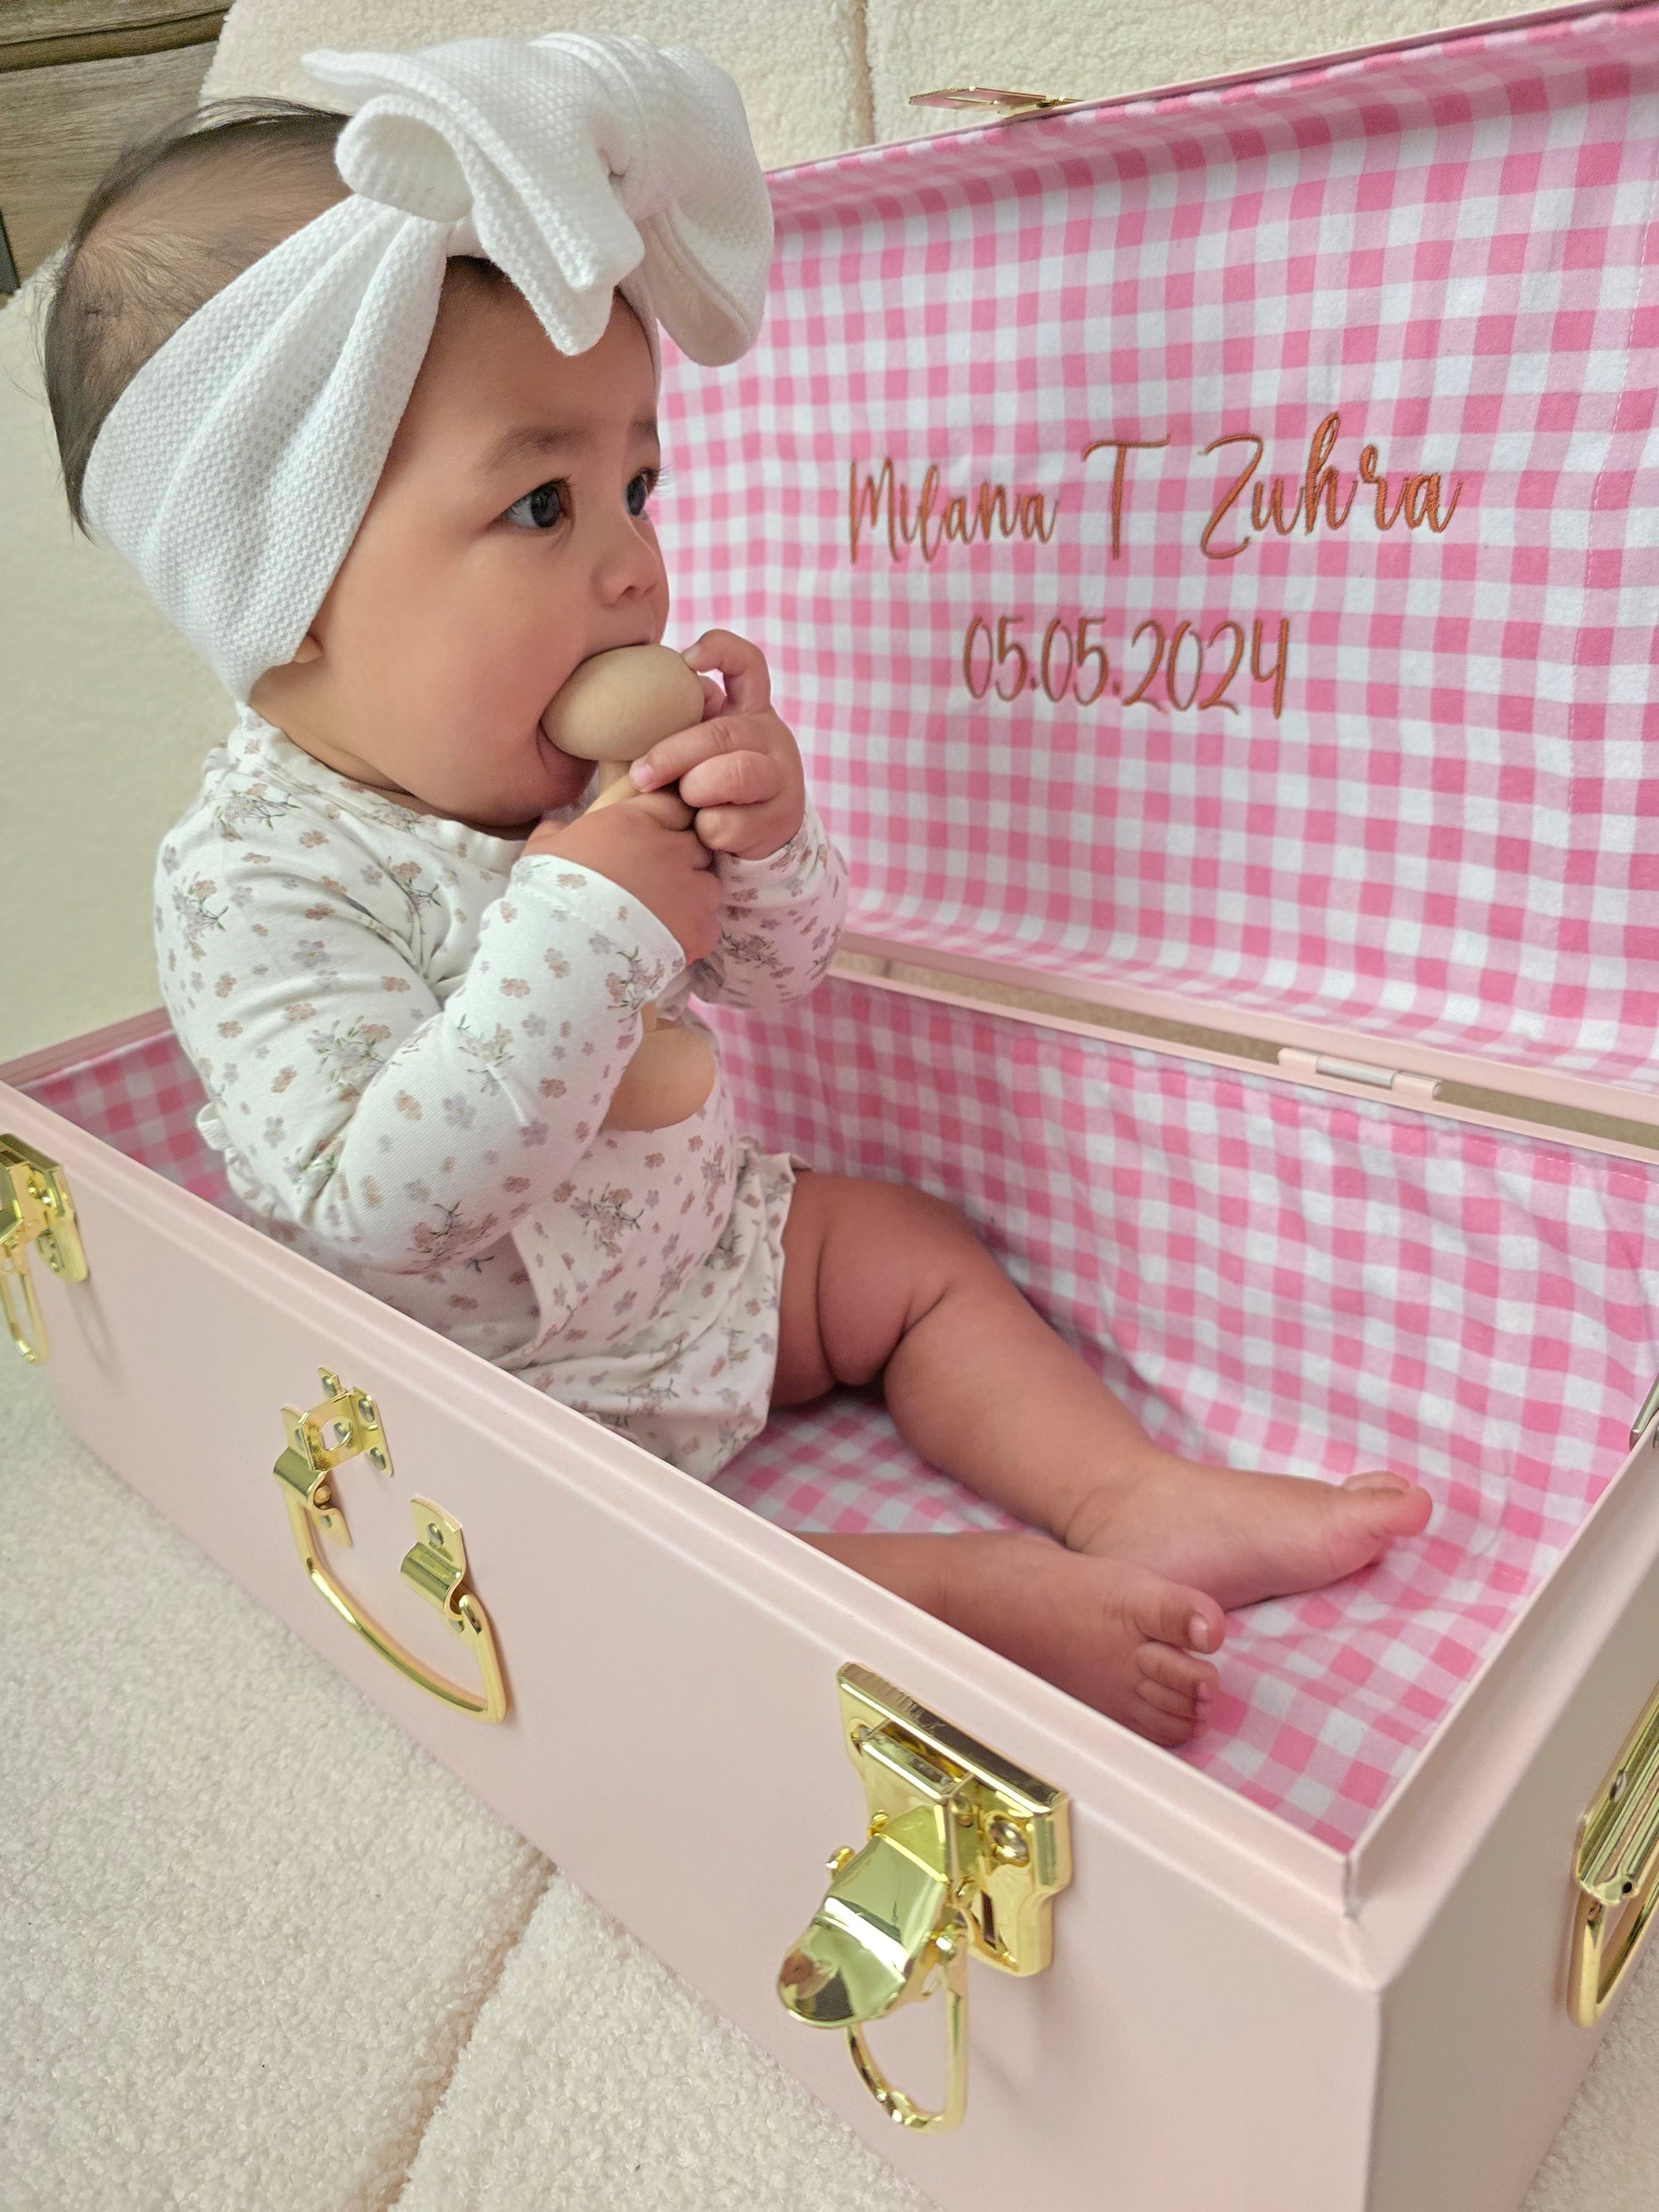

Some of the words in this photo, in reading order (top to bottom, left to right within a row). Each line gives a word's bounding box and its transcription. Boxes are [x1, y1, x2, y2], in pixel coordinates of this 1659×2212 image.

[849, 457, 1058, 563] Milana
[1082, 435, 1171, 560] T
[1197, 412, 1464, 560] Zuhra
[963, 615, 1290, 718] 05.05.2024
